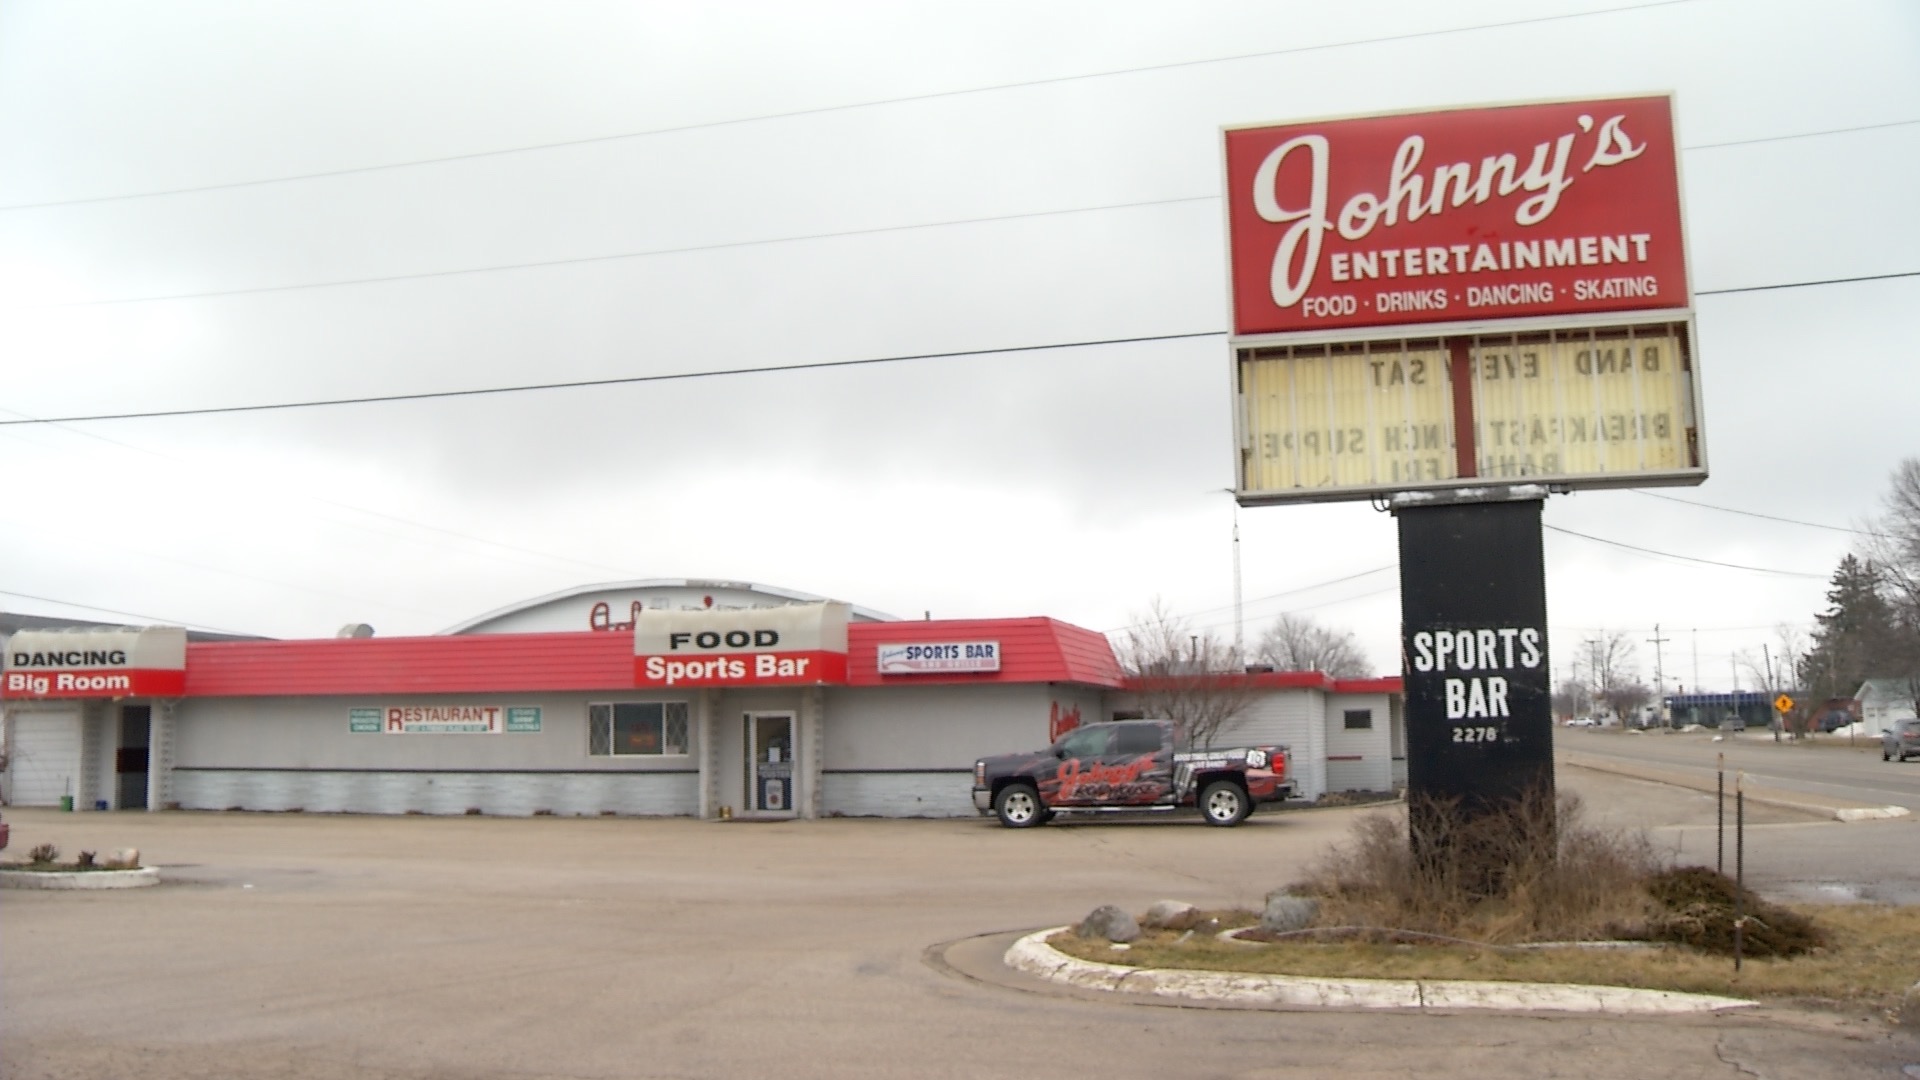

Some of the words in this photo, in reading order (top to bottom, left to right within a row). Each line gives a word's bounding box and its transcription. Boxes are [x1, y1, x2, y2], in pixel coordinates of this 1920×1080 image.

[1253, 115, 1647, 308] Johnny's
[1331, 234, 1651, 282] ENTERTAINMENT
[1302, 296, 1357, 318] FOOD
[1376, 289, 1448, 313] DRINKS
[1467, 282, 1553, 308] DANCING
[1574, 276, 1657, 300] SKATING
[670, 630, 780, 650] FOOD
[906, 645, 959, 660] SPORTS
[965, 644, 994, 659] BAR
[1413, 627, 1541, 672] SPORTS
[13, 650, 126, 667] DANCING
[645, 656, 747, 685] Sports
[756, 654, 810, 678] Bar
[8, 674, 49, 694] Big
[57, 674, 130, 691] Room
[1445, 677, 1510, 719] BAR
[388, 708, 499, 731] RESTAURANT
